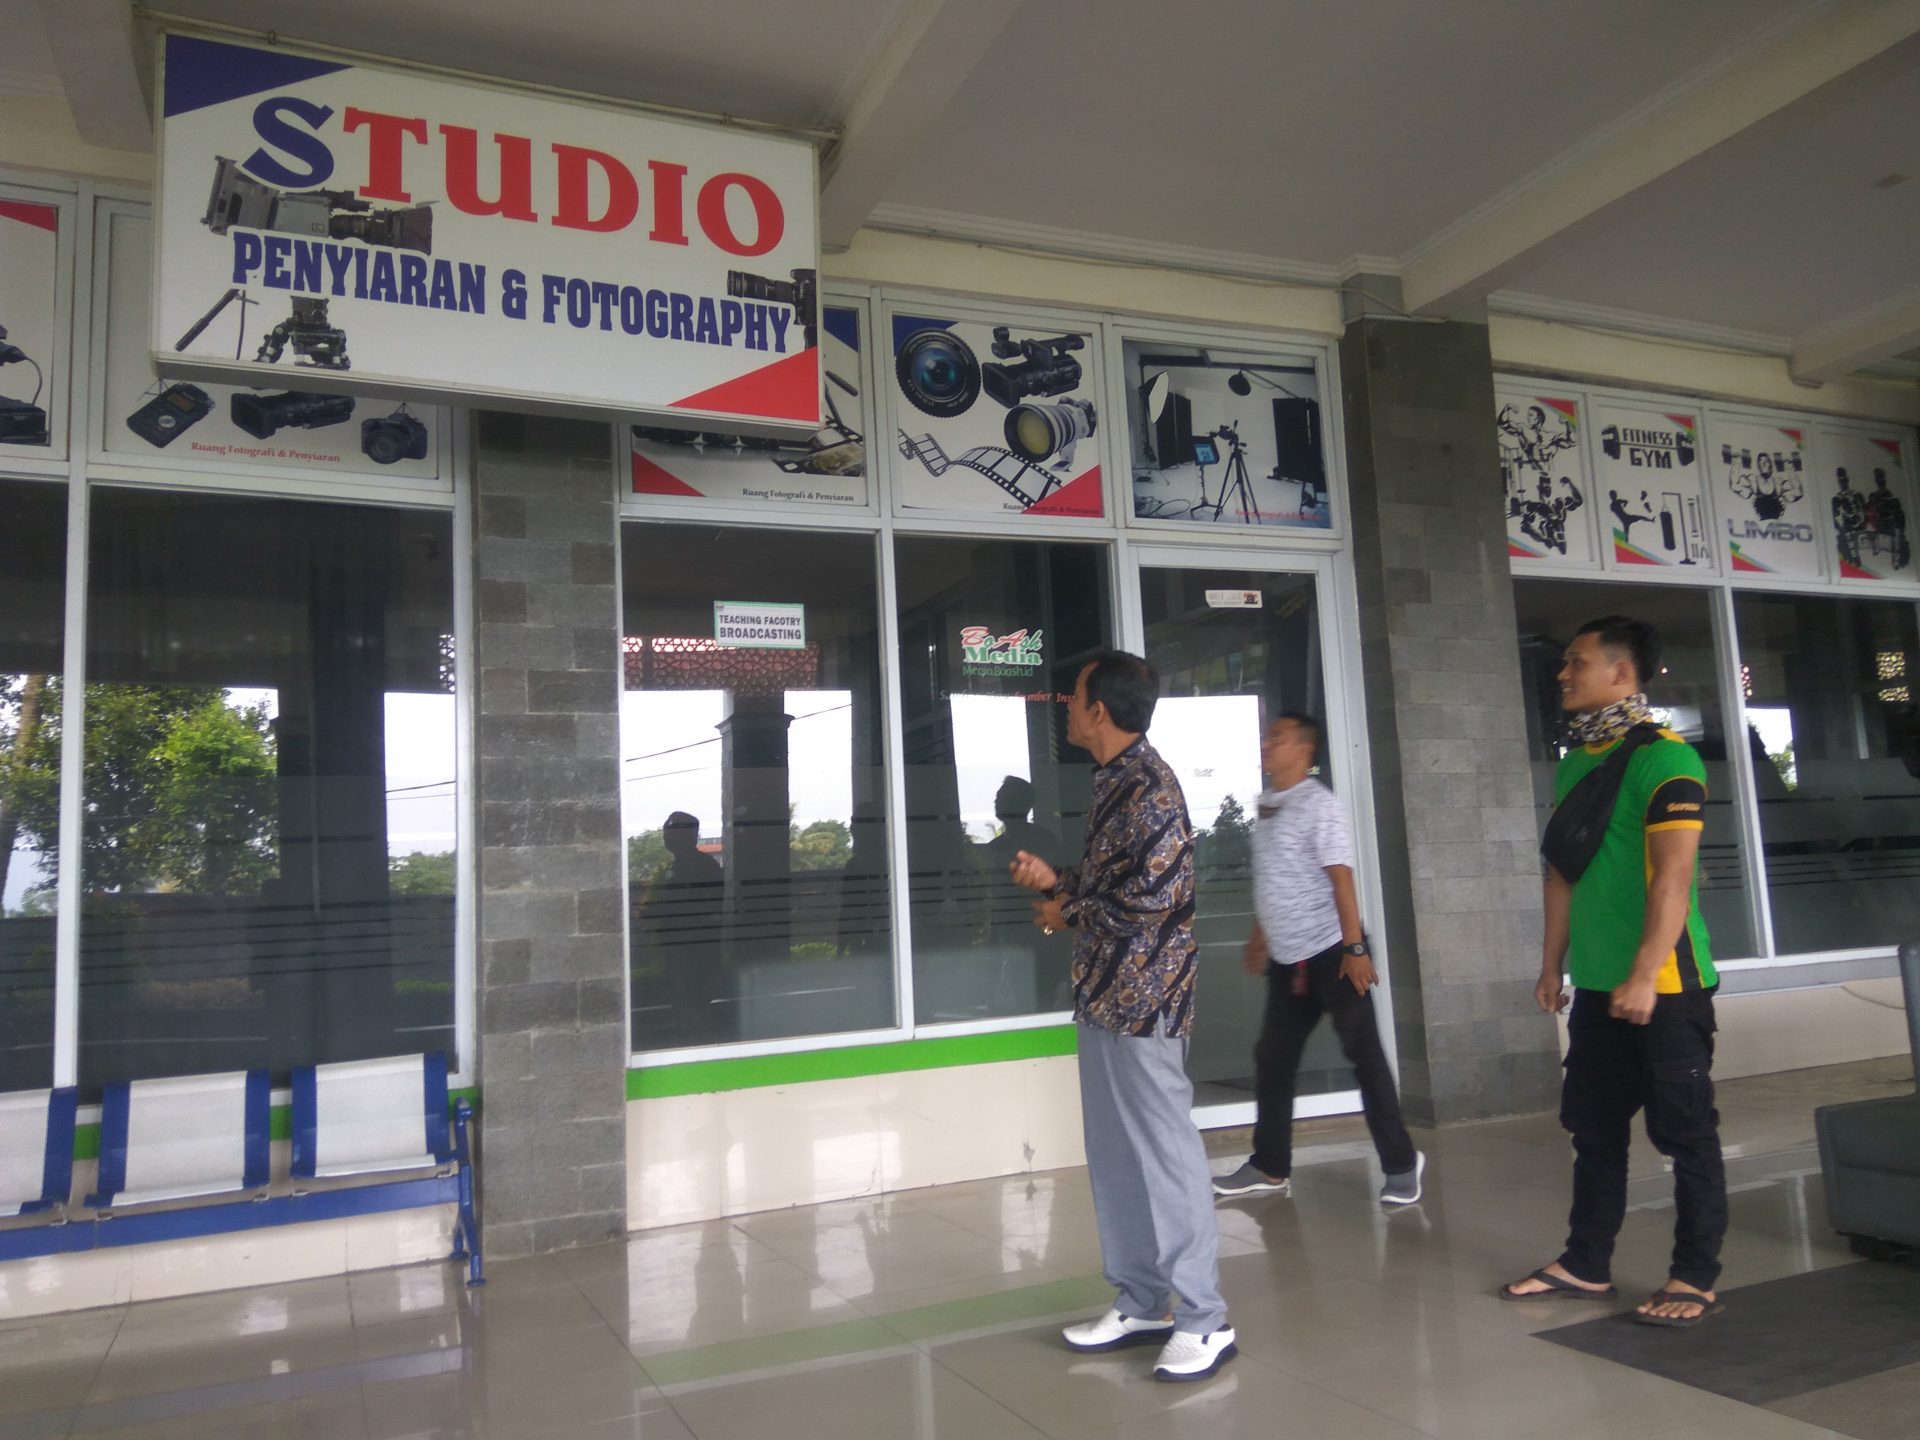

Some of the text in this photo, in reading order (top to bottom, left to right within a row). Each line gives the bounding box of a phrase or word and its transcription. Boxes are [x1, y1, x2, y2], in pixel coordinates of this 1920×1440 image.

[242, 96, 785, 257] STUDIO
[232, 232, 792, 353] PENYIARAN & FOTOGRAPHY
[1629, 447, 1672, 469] GYM
[1727, 518, 1813, 543] LIMBO
[719, 615, 801, 627] TEACHING FACOTRY
[719, 627, 803, 640] BROADCASTING
[962, 646, 1043, 665] Media
